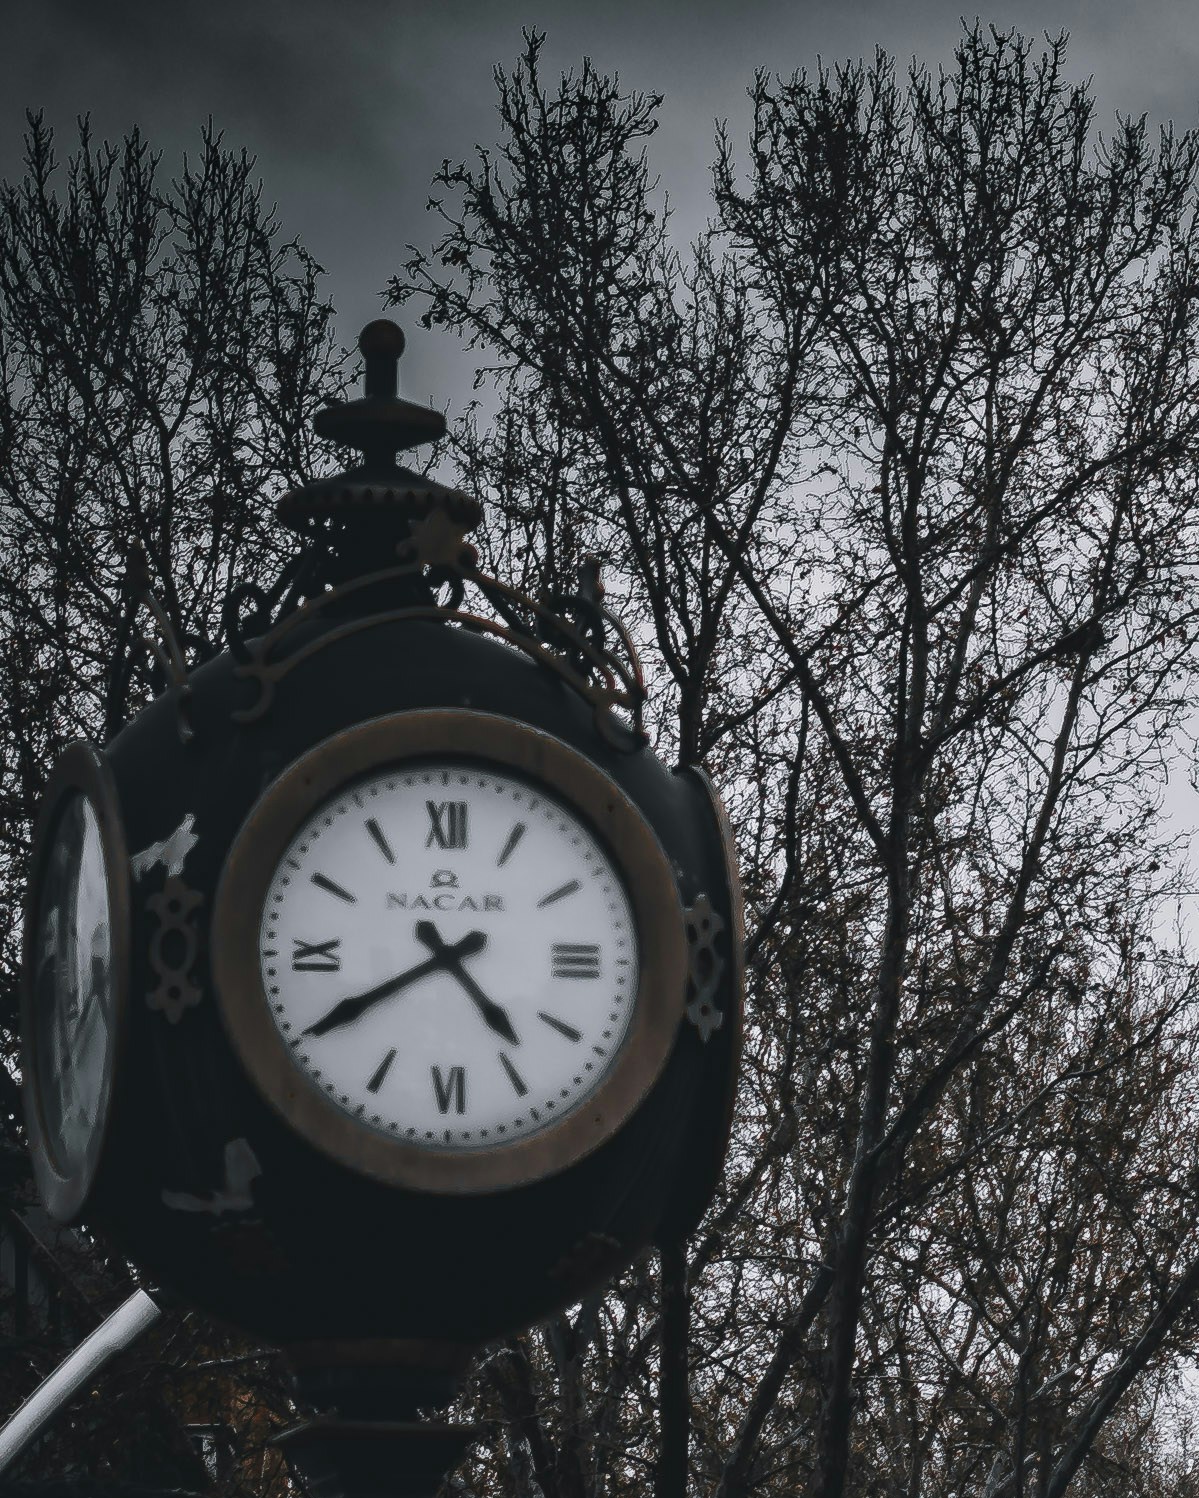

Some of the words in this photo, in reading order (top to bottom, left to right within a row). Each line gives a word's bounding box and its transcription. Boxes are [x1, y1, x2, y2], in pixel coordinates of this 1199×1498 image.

[425, 801, 470, 850] XII
[387, 892, 506, 912] NACAR
[431, 1065, 467, 1114] VI
